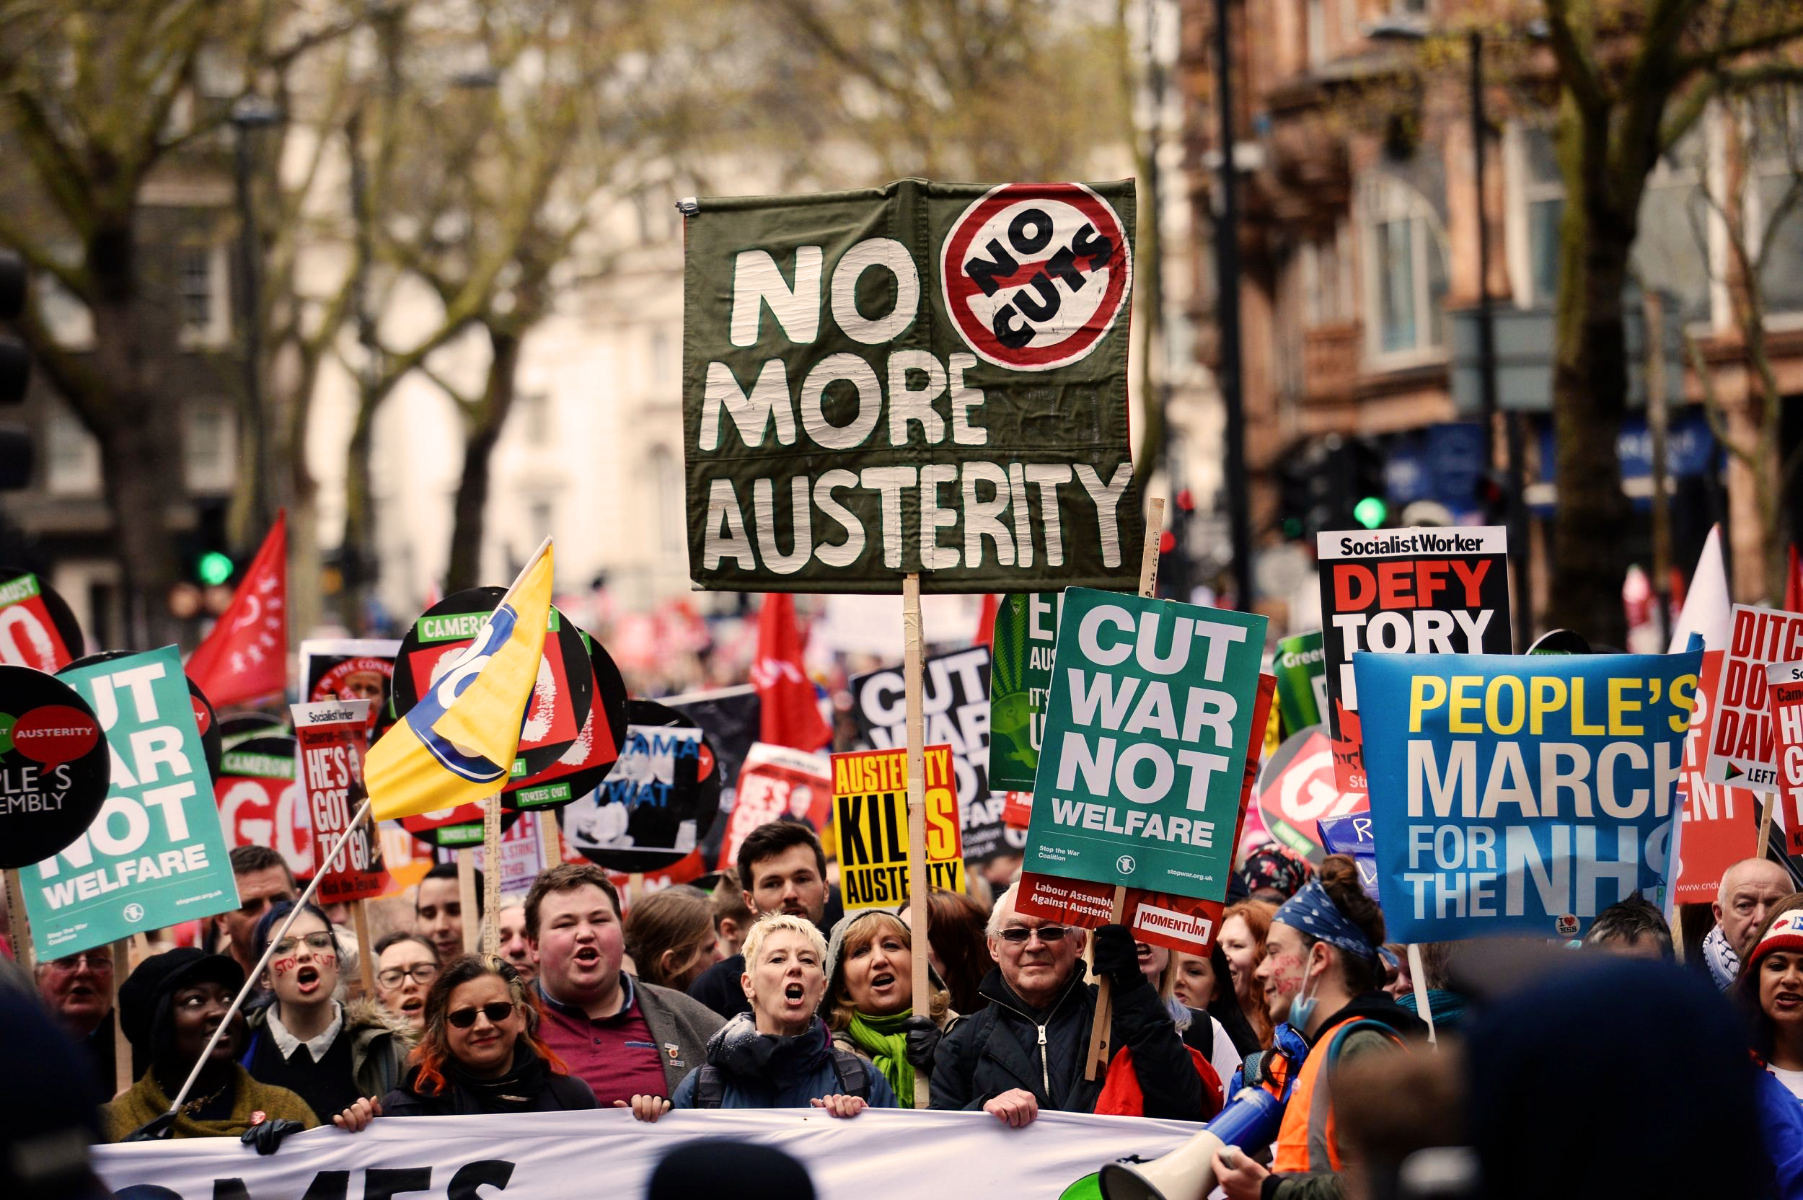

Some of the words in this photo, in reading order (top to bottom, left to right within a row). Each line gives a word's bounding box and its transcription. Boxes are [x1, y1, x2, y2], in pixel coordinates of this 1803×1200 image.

[965, 207, 1054, 298] NO
[729, 237, 921, 347] NO
[992, 223, 1114, 349] CUTS
[698, 349, 988, 452] MORE
[702, 461, 1134, 575] AUSTERITY
[1340, 535, 1418, 556] Socialist
[1419, 534, 1484, 552] Worker
[1333, 559, 1492, 612] DEFY
[1078, 605, 1248, 682] CUT
[1332, 609, 1495, 661] TORY
[70, 662, 166, 733] UT
[860, 648, 989, 728] CUT
[1067, 668, 1238, 748] WAR
[1408, 674, 1698, 736] PEOPLE'S
[1723, 659, 1770, 713] DO
[16, 727, 93, 739] AUSTERITY
[306, 746, 349, 790] HE'S
[836, 750, 948, 794] AUSTERTY
[1055, 731, 1230, 812] NOT
[1407, 739, 1686, 819] MARCH
[312, 788, 350, 833] GOT
[519, 790, 549, 803] TORIES
[551, 786, 568, 798] OUT
[838, 788, 957, 866] KILS
[1051, 798, 1215, 848] WELFARE
[1407, 824, 1497, 869] FOR
[317, 831, 347, 875] TO
[1038, 852, 1066, 862] Coalition
[1039, 845, 1054, 854] Stop
[1055, 847, 1066, 855] the
[1067, 849, 1080, 857] War
[1167, 868, 1214, 882] stopwar.org.uk
[42, 844, 210, 910] WELFARE
[846, 862, 957, 905] AUSTEITY
[1035, 882, 1068, 897] Labour
[1069, 886, 1114, 909] Assembly
[1403, 872, 1497, 920] THE
[1031, 893, 1068, 910] Against
[1069, 902, 1113, 922] Austerity
[1139, 911, 1205, 937] MOMENTUM
[1560, 926, 1578, 934] NHS
